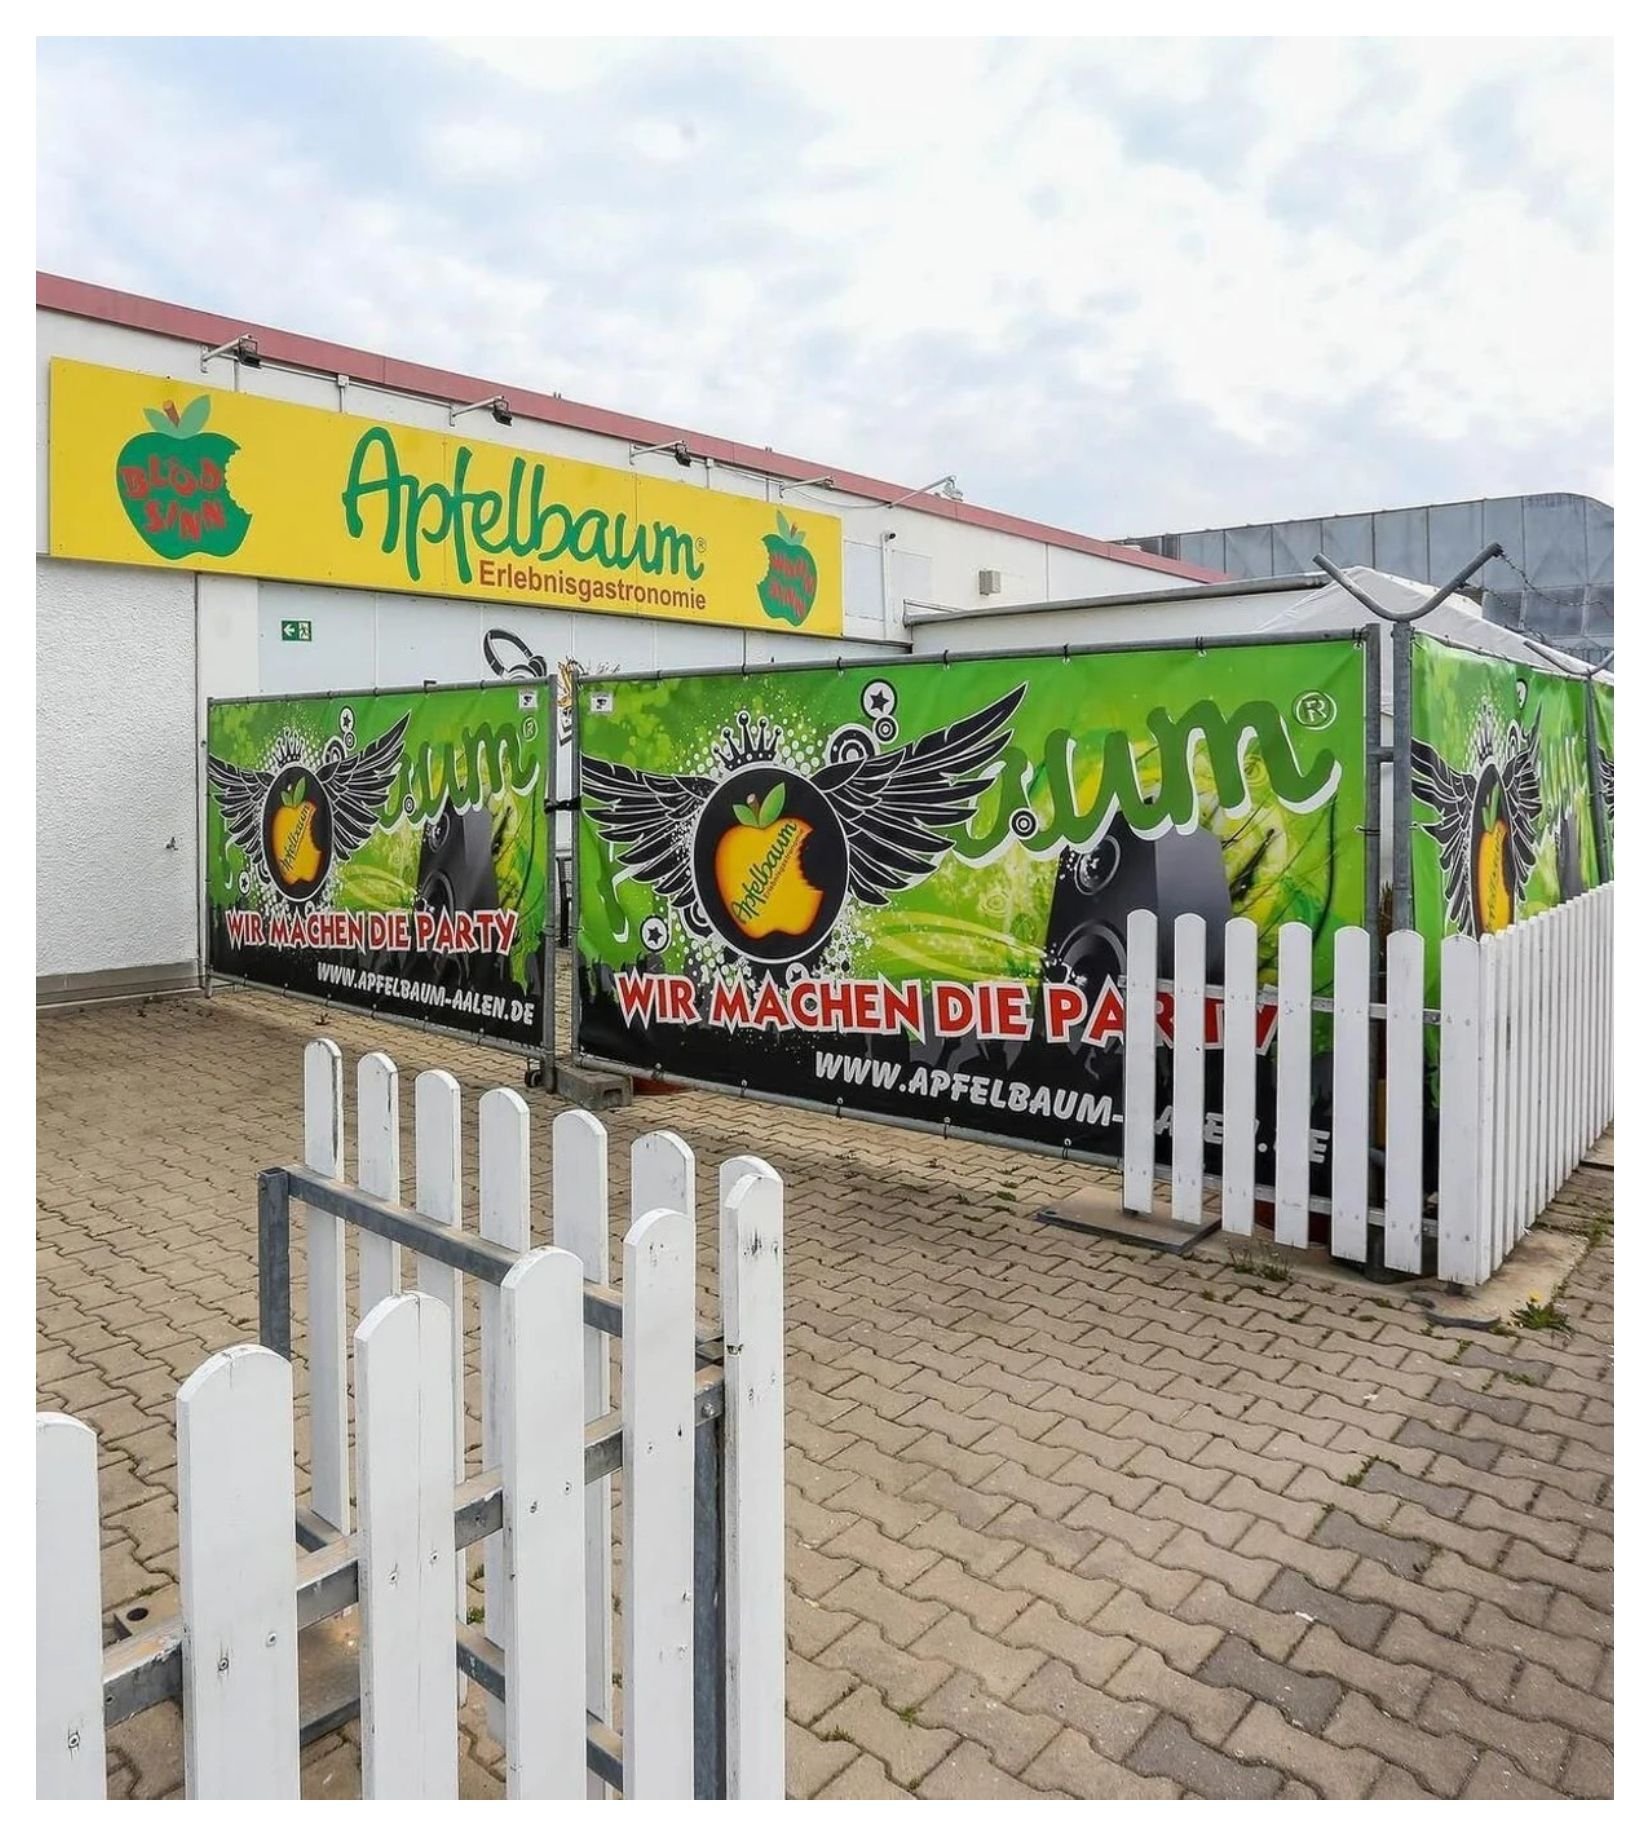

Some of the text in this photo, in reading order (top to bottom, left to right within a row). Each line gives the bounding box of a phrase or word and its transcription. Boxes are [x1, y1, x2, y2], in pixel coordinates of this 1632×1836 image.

[145, 499, 226, 542] SINN
[478, 559, 707, 610] Erlebnisgastronomie
[225, 905, 519, 956] WIR MACHEN DIE PARTY
[316, 961, 535, 1026] WWW.APFELBAUM-AALEN.DE
[613, 968, 701, 1030] WIR
[708, 968, 926, 1044] MACHEN
[931, 979, 1035, 1042] DIE
